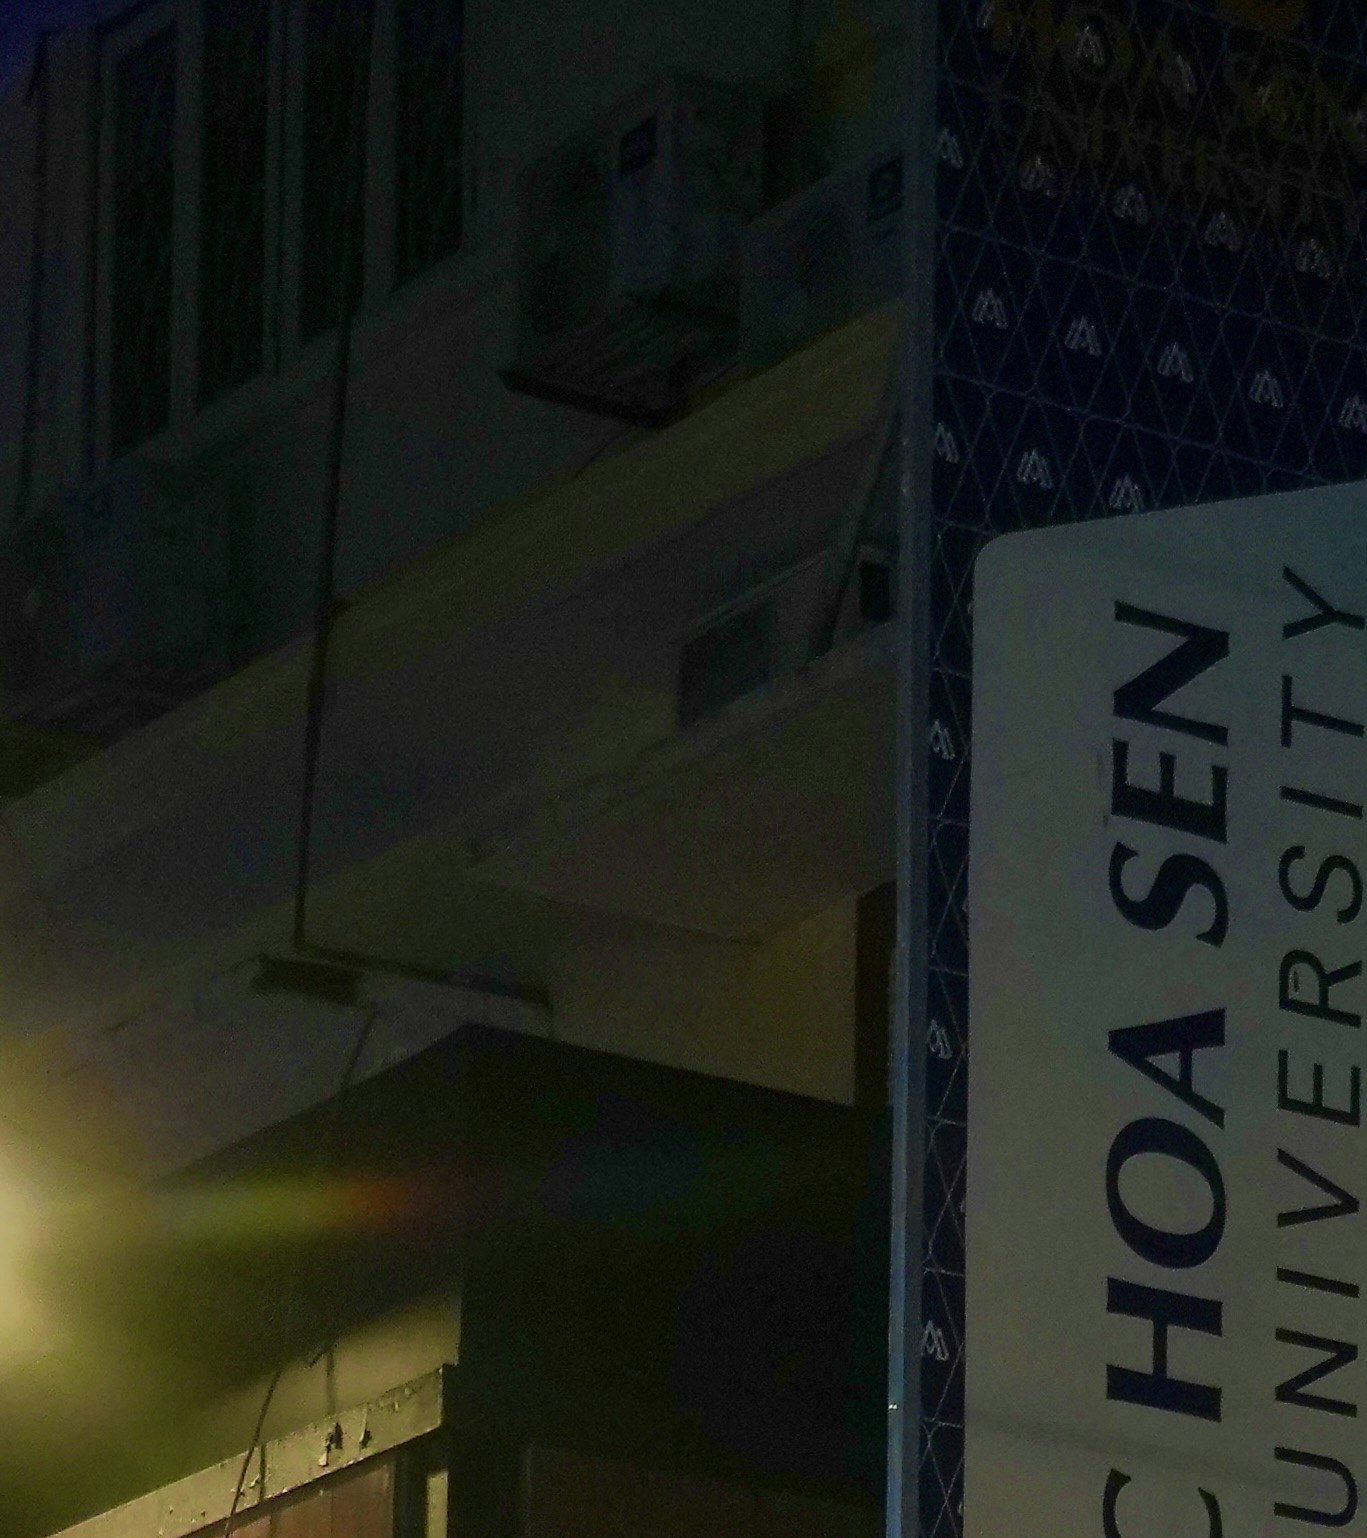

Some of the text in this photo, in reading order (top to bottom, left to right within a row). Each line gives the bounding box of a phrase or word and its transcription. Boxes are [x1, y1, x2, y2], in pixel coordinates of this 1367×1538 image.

[1108, 600, 1230, 948] SEN
[1104, 1007, 1228, 1422] HOA
[1273, 566, 1366, 1528] UNIVERSITY
